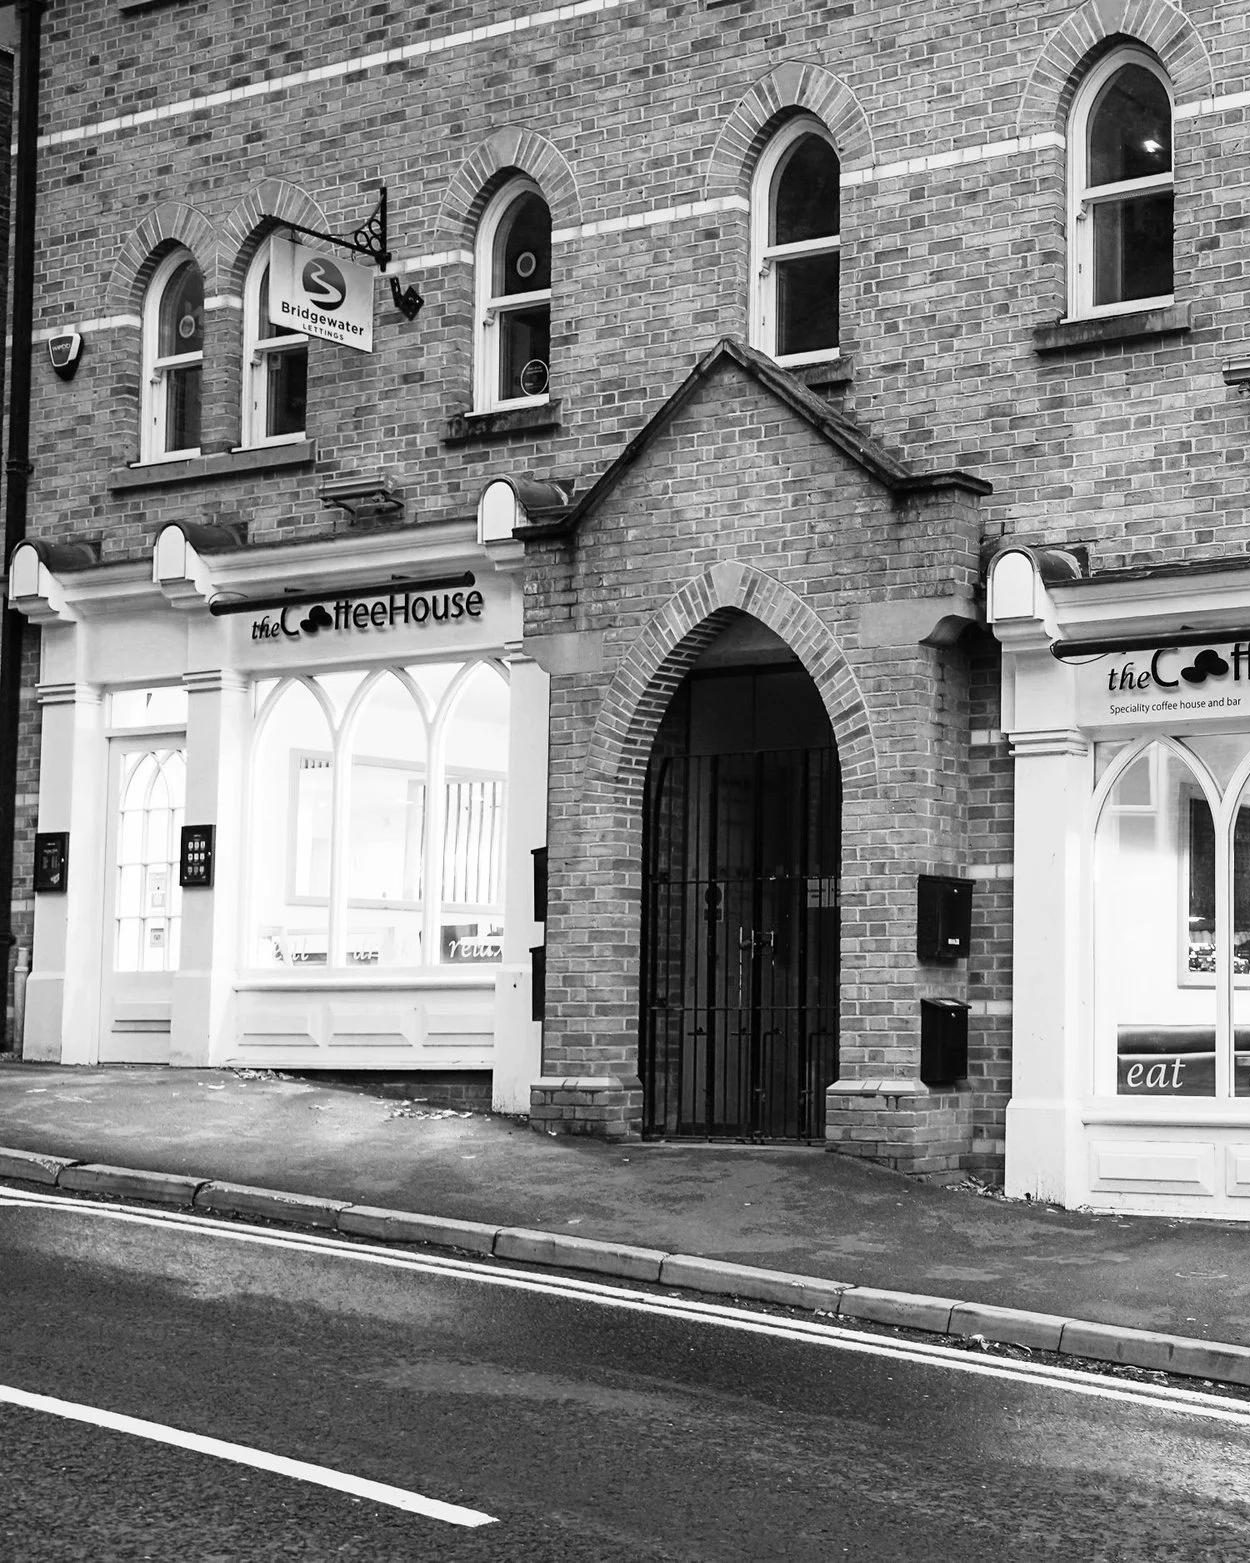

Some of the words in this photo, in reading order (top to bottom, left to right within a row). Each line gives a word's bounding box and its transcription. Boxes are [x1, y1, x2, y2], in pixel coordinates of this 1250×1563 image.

[281, 301, 365, 336] Bridgewater
[302, 323, 345, 341] LETTINGS
[1109, 703, 1150, 716] Speciality
[1151, 700, 1178, 712] coffee
[1179, 698, 1206, 710] house
[1207, 697, 1225, 708] and
[1226, 695, 1242, 707] bar
[1126, 1057, 1187, 1089] eat
